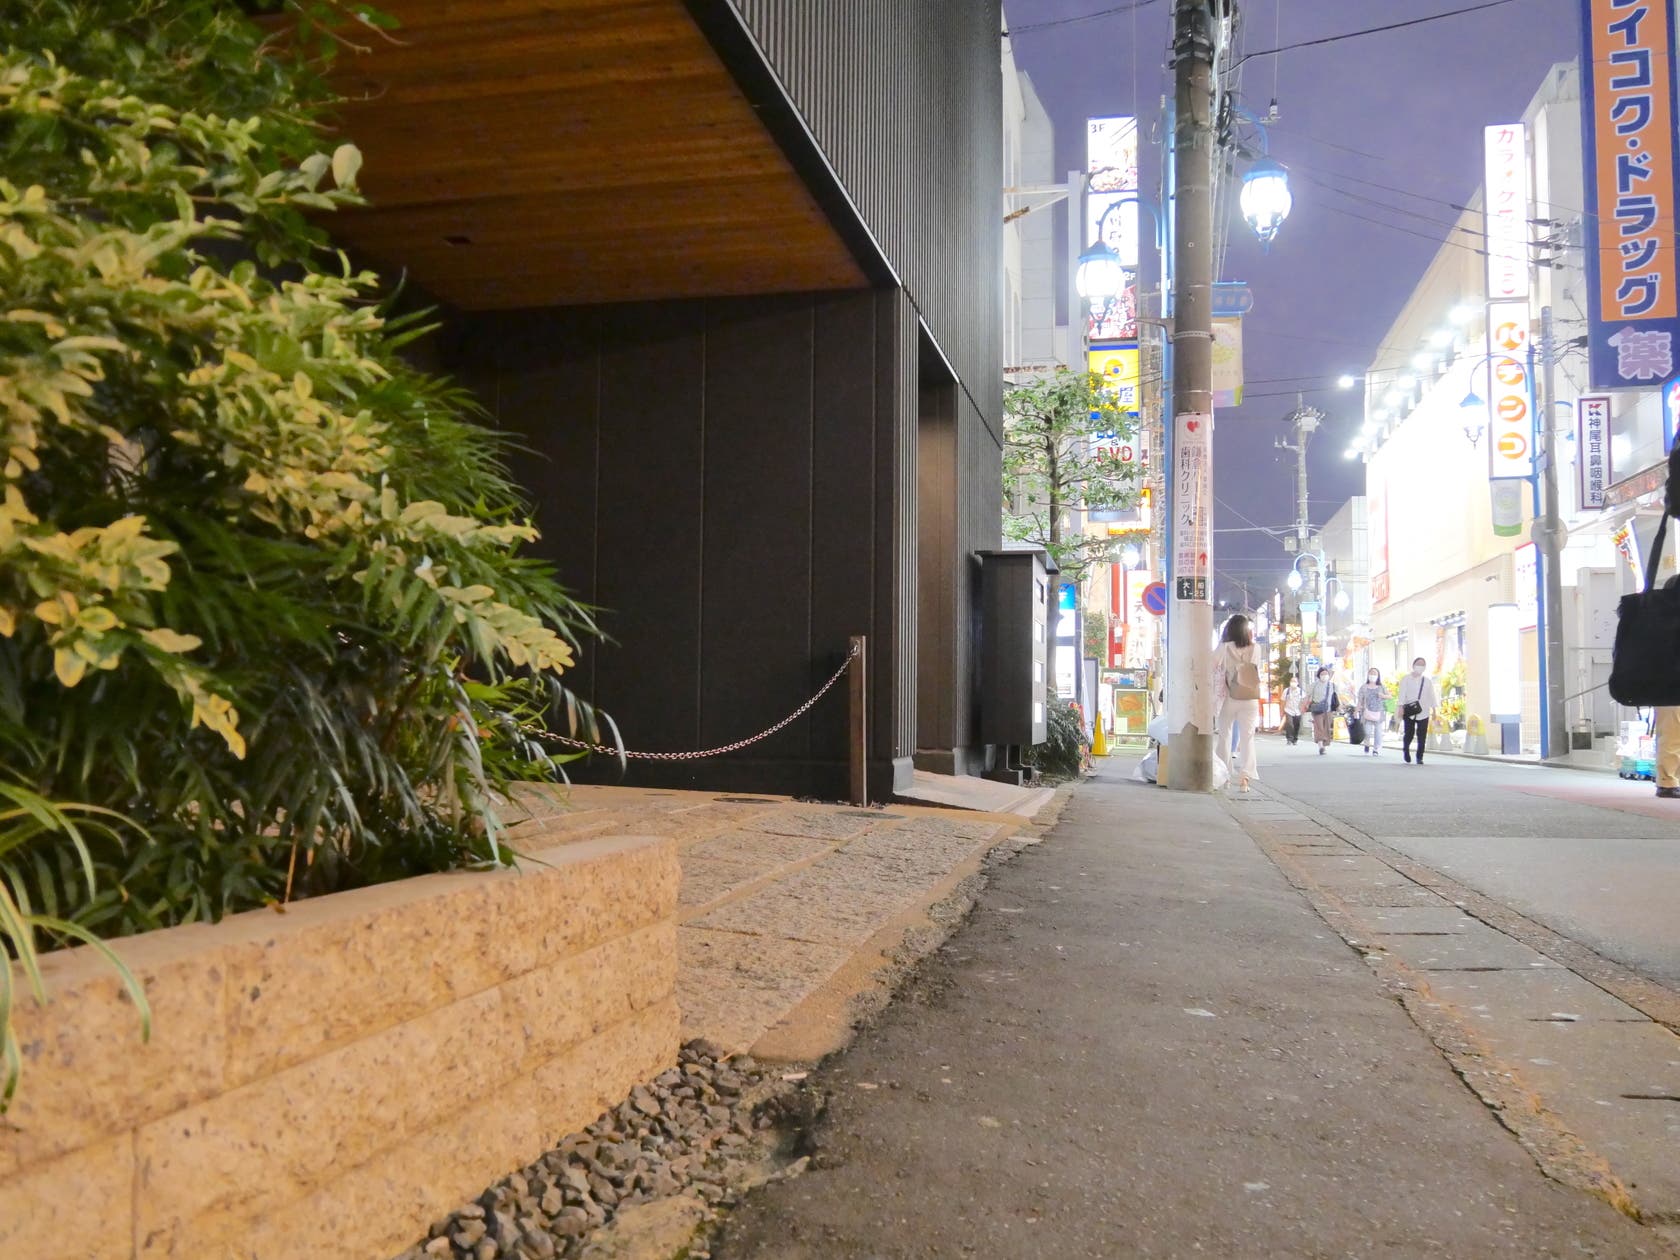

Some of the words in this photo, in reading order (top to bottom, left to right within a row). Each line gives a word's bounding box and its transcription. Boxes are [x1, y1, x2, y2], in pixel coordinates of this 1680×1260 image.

[1090, 123, 1106, 134] 3F
[1608, 0, 1660, 317] イコク・ドラッグ
[1609, 327, 1674, 380] 薬
[1097, 445, 1133, 463] DVD
[1180, 446, 1191, 525] 歯科クリニック
[1588, 417, 1603, 505] 神尾耳鼻咽喉科
